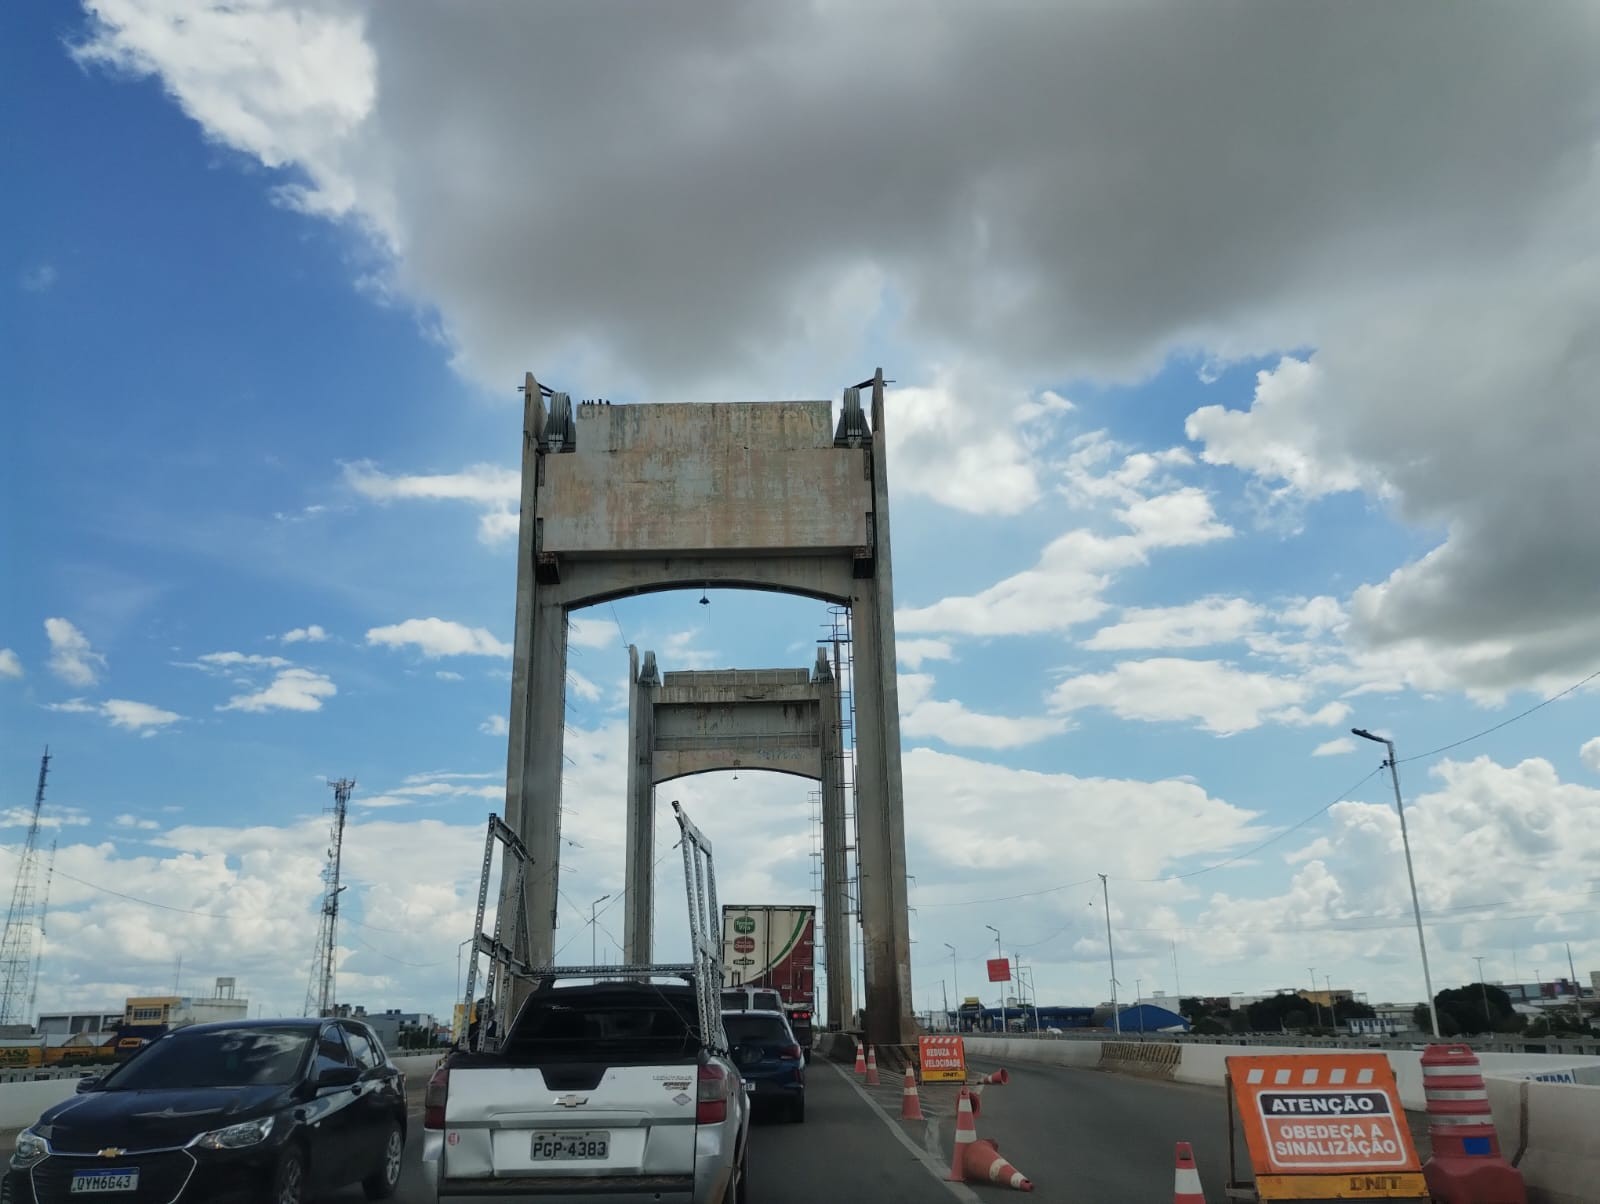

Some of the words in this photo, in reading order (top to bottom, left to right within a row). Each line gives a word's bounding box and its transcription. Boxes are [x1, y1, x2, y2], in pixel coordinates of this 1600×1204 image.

[926, 1048, 950, 1057] REDUZA
[925, 1059, 961, 1068] VELOCIDADE
[1272, 1096, 1374, 1115] ATENÇÃO
[1280, 1124, 1366, 1141] OBEDEÇA
[1370, 1123, 1384, 1138] A
[1275, 1137, 1397, 1158] SINALIZAÇÃO
[1350, 1176, 1402, 1191] DNIT
